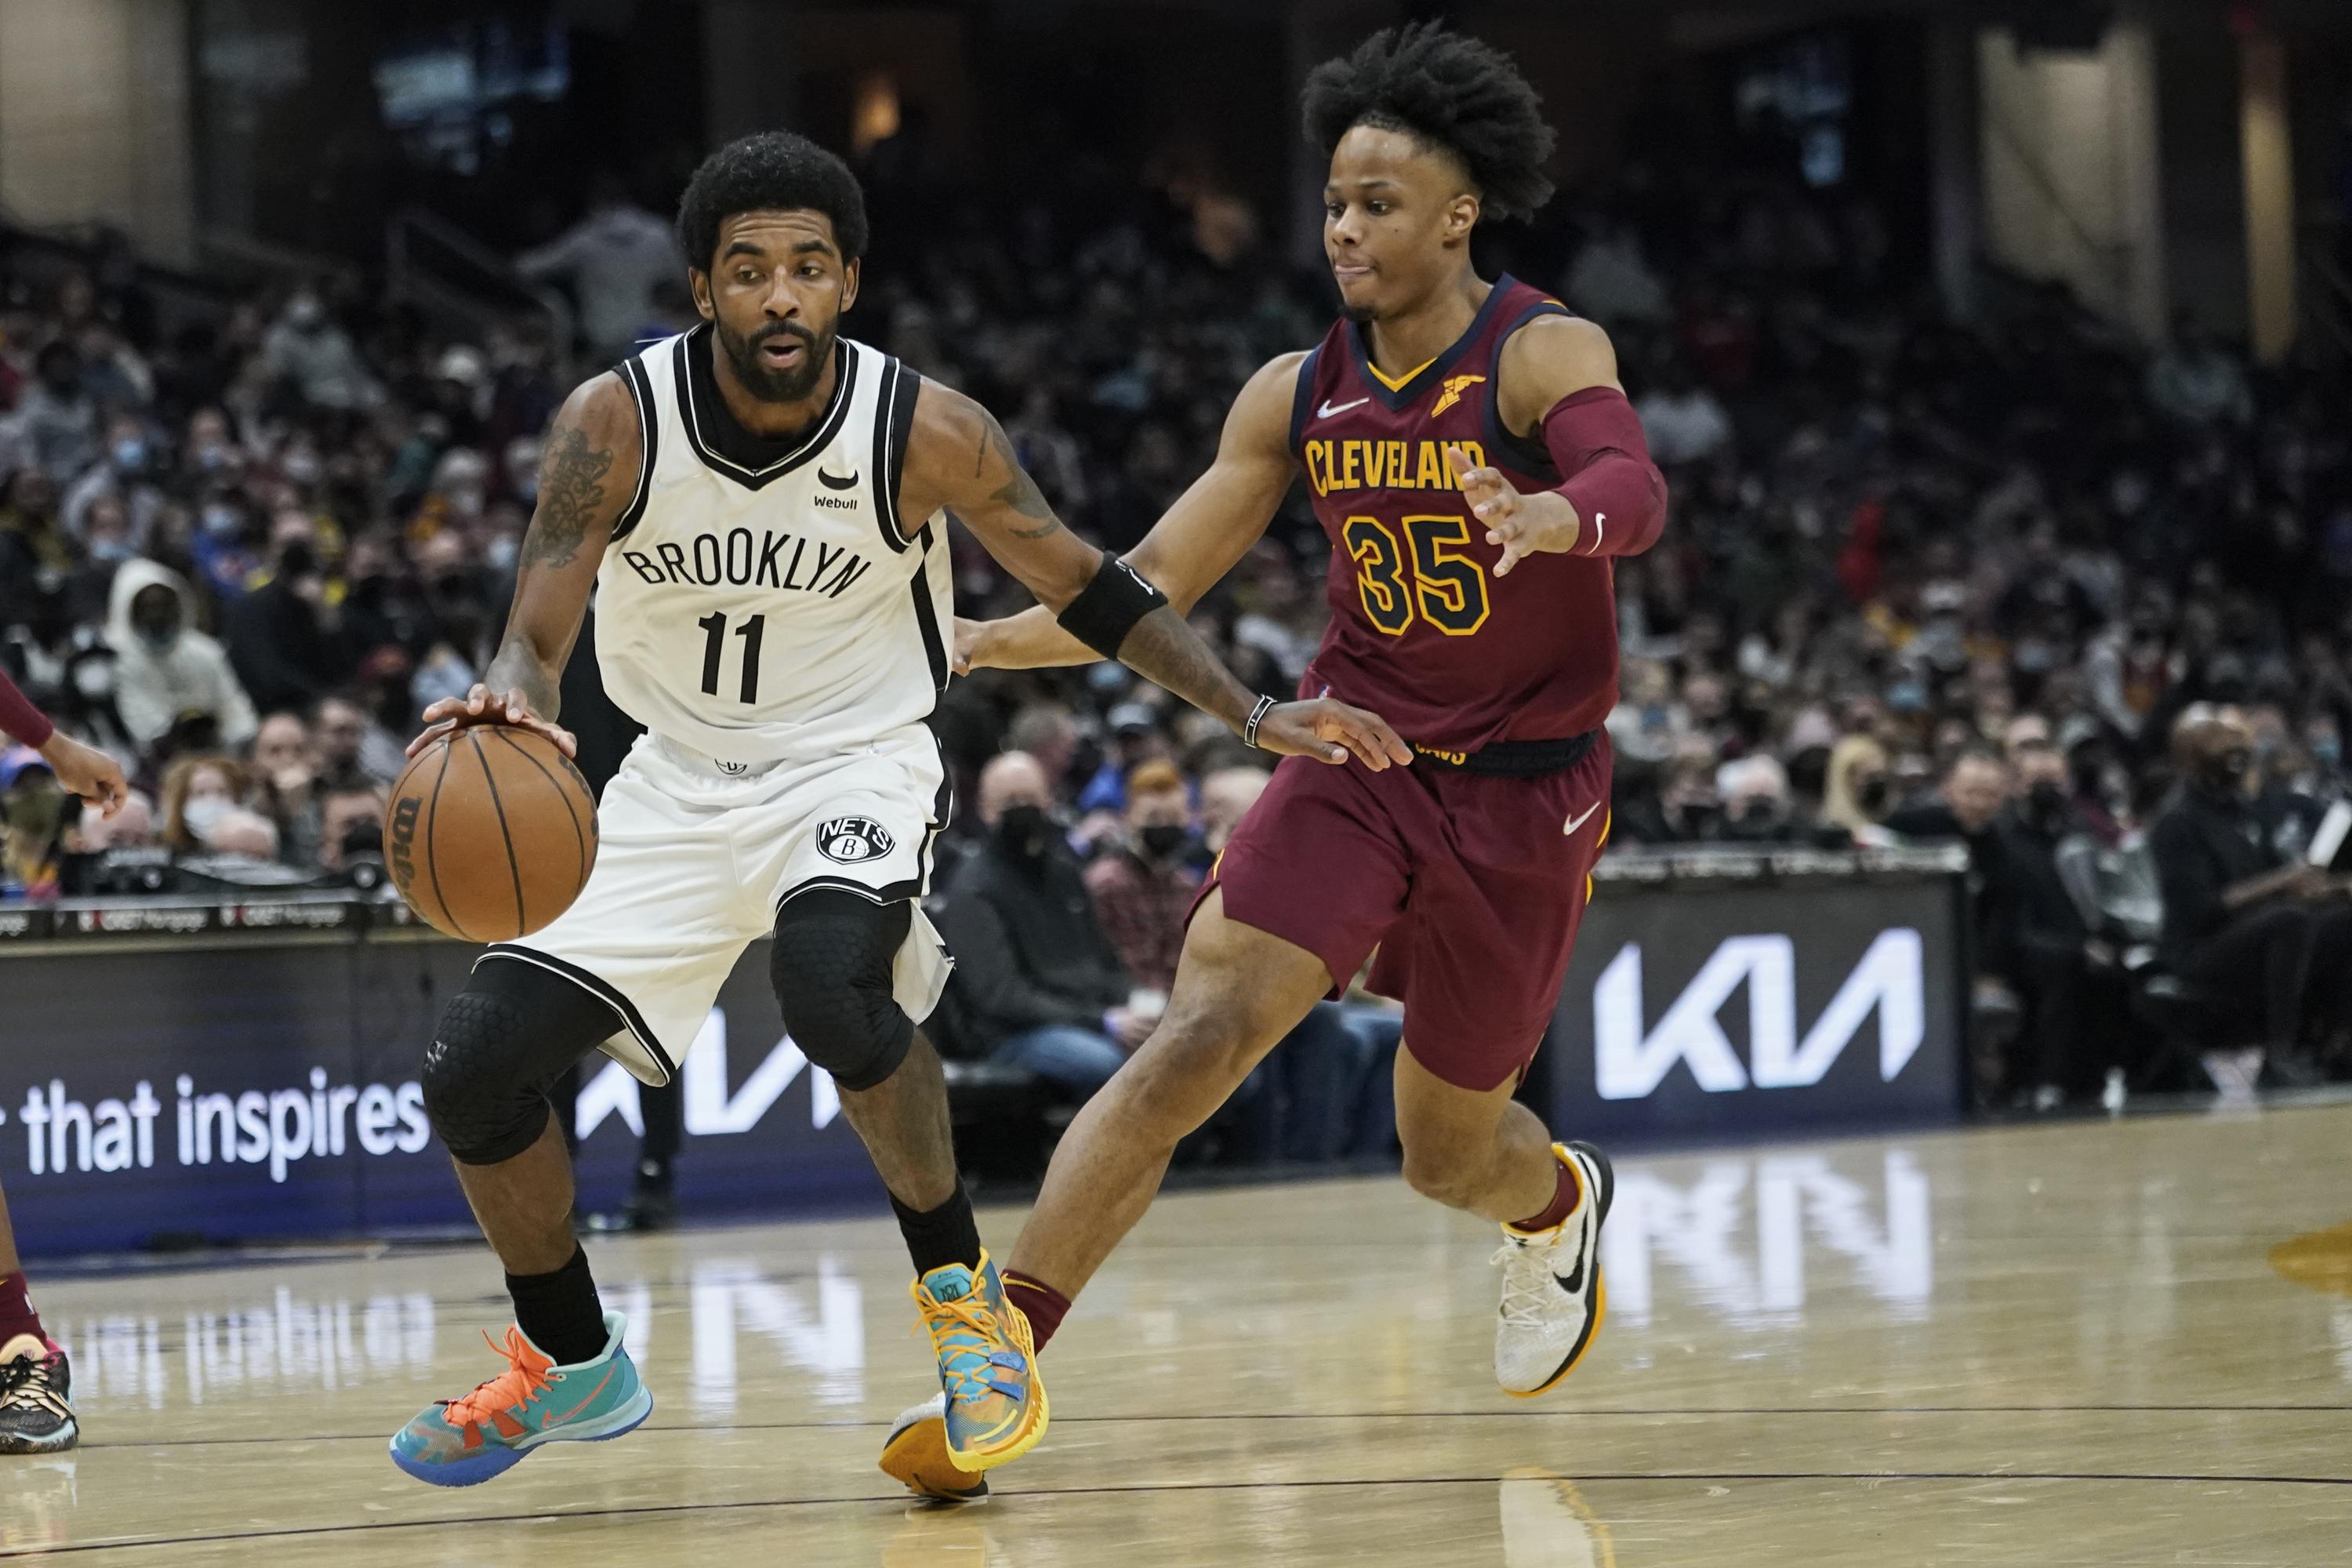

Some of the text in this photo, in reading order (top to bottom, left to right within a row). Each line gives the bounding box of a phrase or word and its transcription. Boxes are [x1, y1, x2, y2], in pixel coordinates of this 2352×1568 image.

[814, 495, 858, 510] Webull
[622, 527, 871, 598] BROOKLYN
[1342, 516, 1490, 636] 35
[698, 610, 765, 705] 11
[821, 818, 889, 850] NETS
[20, 1066, 430, 1183] that inspires
